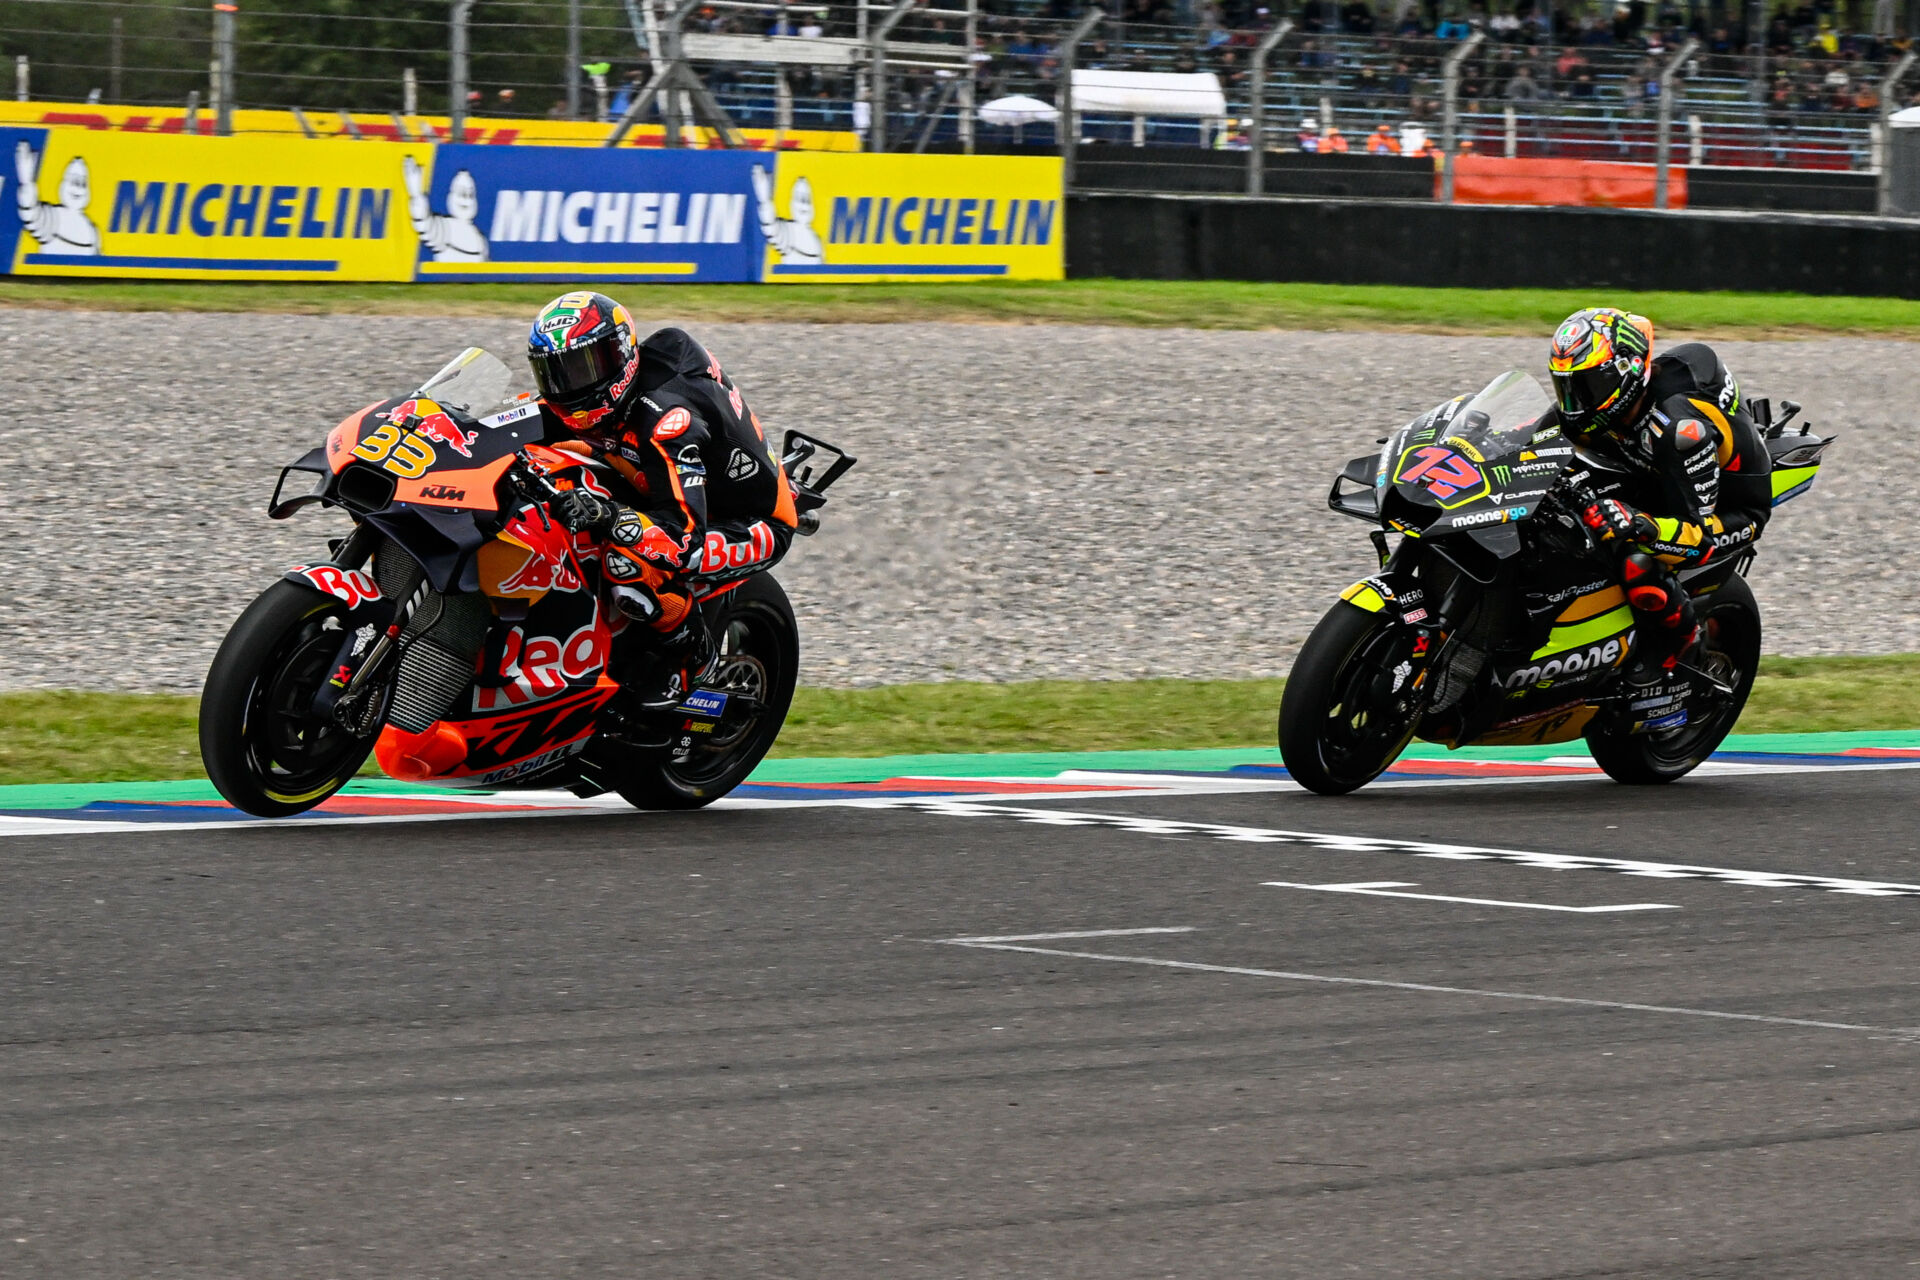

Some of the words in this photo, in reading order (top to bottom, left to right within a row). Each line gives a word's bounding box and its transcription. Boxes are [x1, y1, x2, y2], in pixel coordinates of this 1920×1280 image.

[108, 181, 391, 239] MICHELIN
[490, 190, 747, 244] MICHELIN
[828, 197, 1055, 245] MICHELIN
[542, 317, 574, 331] HJC
[552, 347, 568, 356] YOU
[570, 337, 599, 351] WINGS
[497, 410, 519, 423] Mobil
[1535, 426, 1559, 442] WRS
[350, 424, 437, 479] 33
[1398, 446, 1483, 500] 12
[1512, 462, 1560, 474] MONSTER
[418, 484, 466, 502] KTM
[1504, 490, 1547, 500] CUPRA
[1452, 506, 1528, 529] mooneygo
[699, 520, 775, 574] Bull
[1400, 588, 1424, 605] HERO
[472, 595, 605, 713] Red
[1505, 630, 1636, 689] mooney
[684, 696, 721, 709] CHELIN
[481, 753, 546, 784] Mobil
